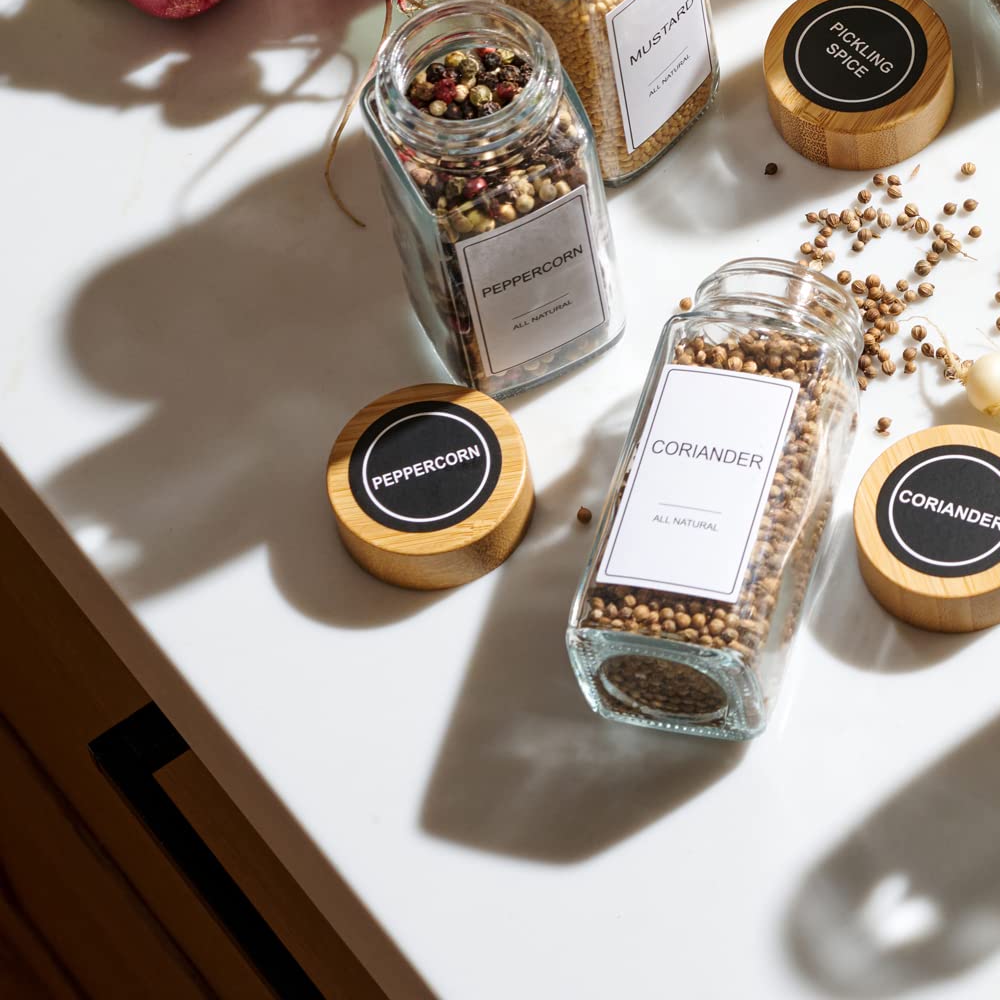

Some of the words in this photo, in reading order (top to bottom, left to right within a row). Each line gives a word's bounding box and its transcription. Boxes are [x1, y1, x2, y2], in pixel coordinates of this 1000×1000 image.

[826, 43, 870, 78] SPICE
[829, 22, 894, 74] PICKLING
[649, 84, 661, 97] ALL
[661, 54, 691, 84] NATURAL
[481, 244, 584, 298] PEPPERCORN
[512, 321, 530, 331] ALL
[531, 300, 573, 323] NATURAL
[371, 444, 481, 490] PEPPERCORN
[651, 439, 764, 470] CORIANDER
[652, 514, 669, 524] ALL
[673, 517, 719, 532] NATURAL
